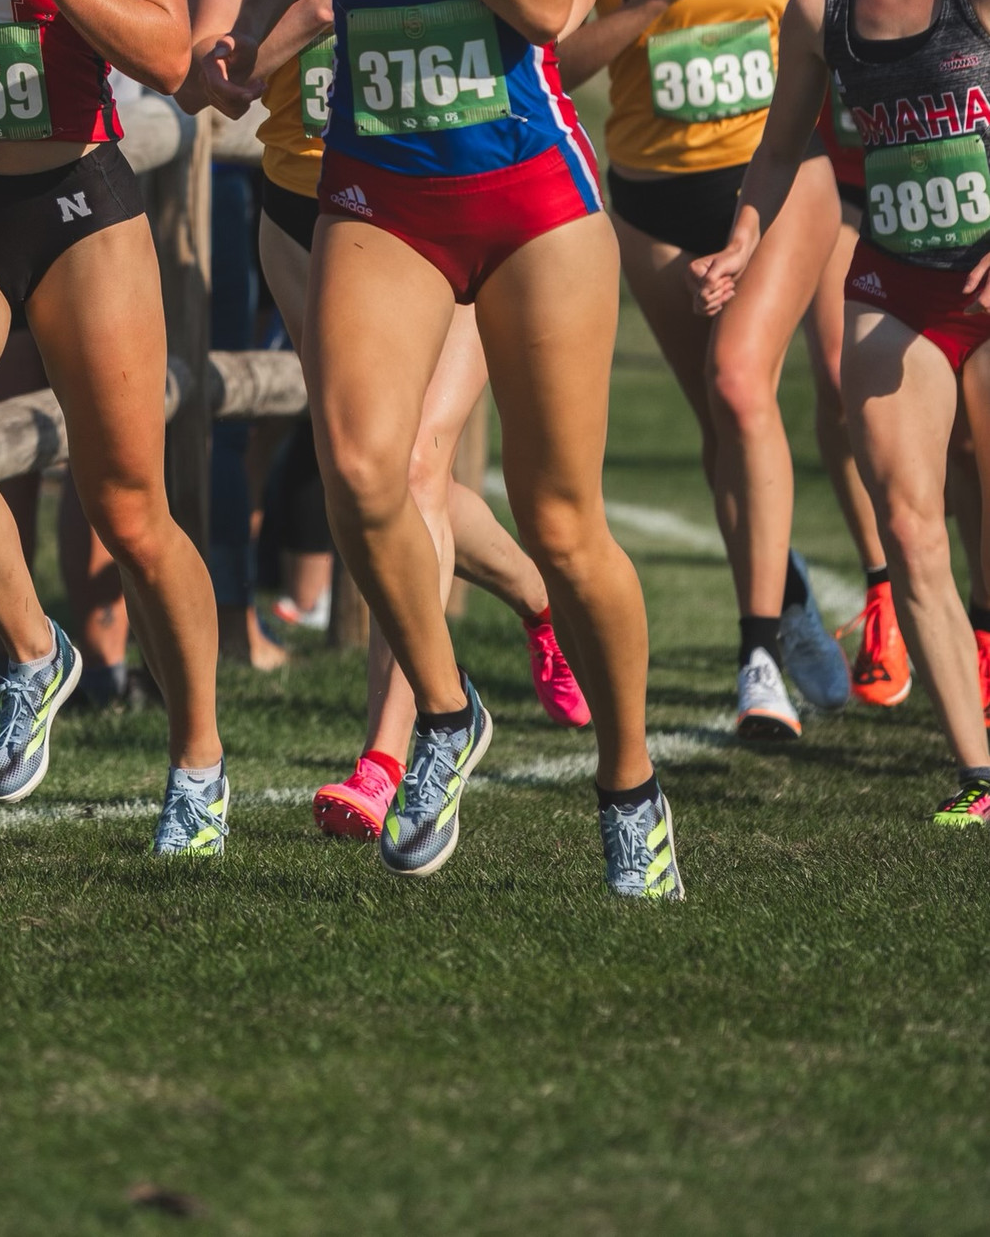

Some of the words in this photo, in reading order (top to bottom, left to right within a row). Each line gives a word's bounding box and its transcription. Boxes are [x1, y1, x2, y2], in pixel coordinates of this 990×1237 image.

[358, 38, 497, 111] 3764
[654, 49, 775, 111] 3838
[57, 191, 92, 222] N
[330, 193, 373, 217] adidas
[870, 171, 990, 235] 3893
